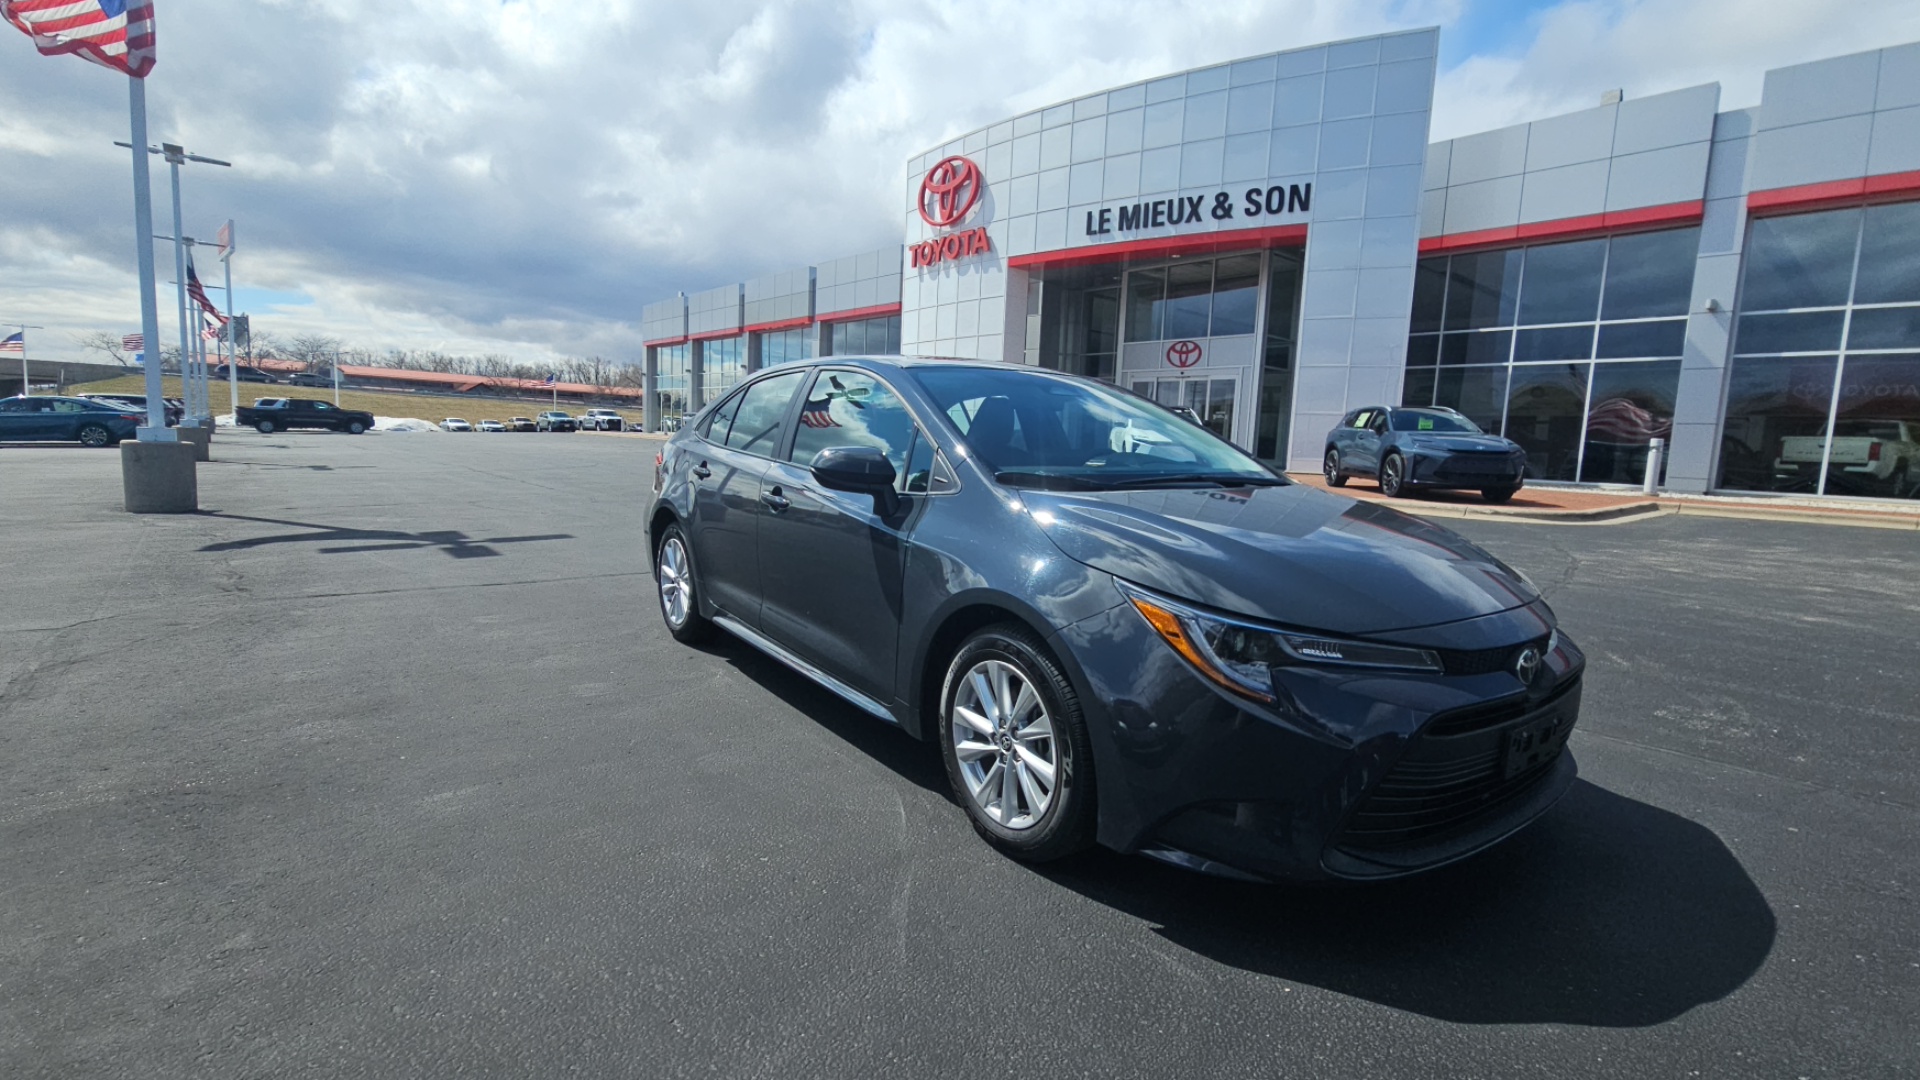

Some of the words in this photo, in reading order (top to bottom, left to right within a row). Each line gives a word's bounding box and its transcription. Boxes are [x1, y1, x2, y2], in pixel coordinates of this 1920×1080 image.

[1086, 208, 1112, 236] LE
[1118, 194, 1205, 232] MIEUX
[1211, 191, 1234, 220] &
[1244, 182, 1312, 217] SON
[909, 227, 991, 269] TOYOTA
